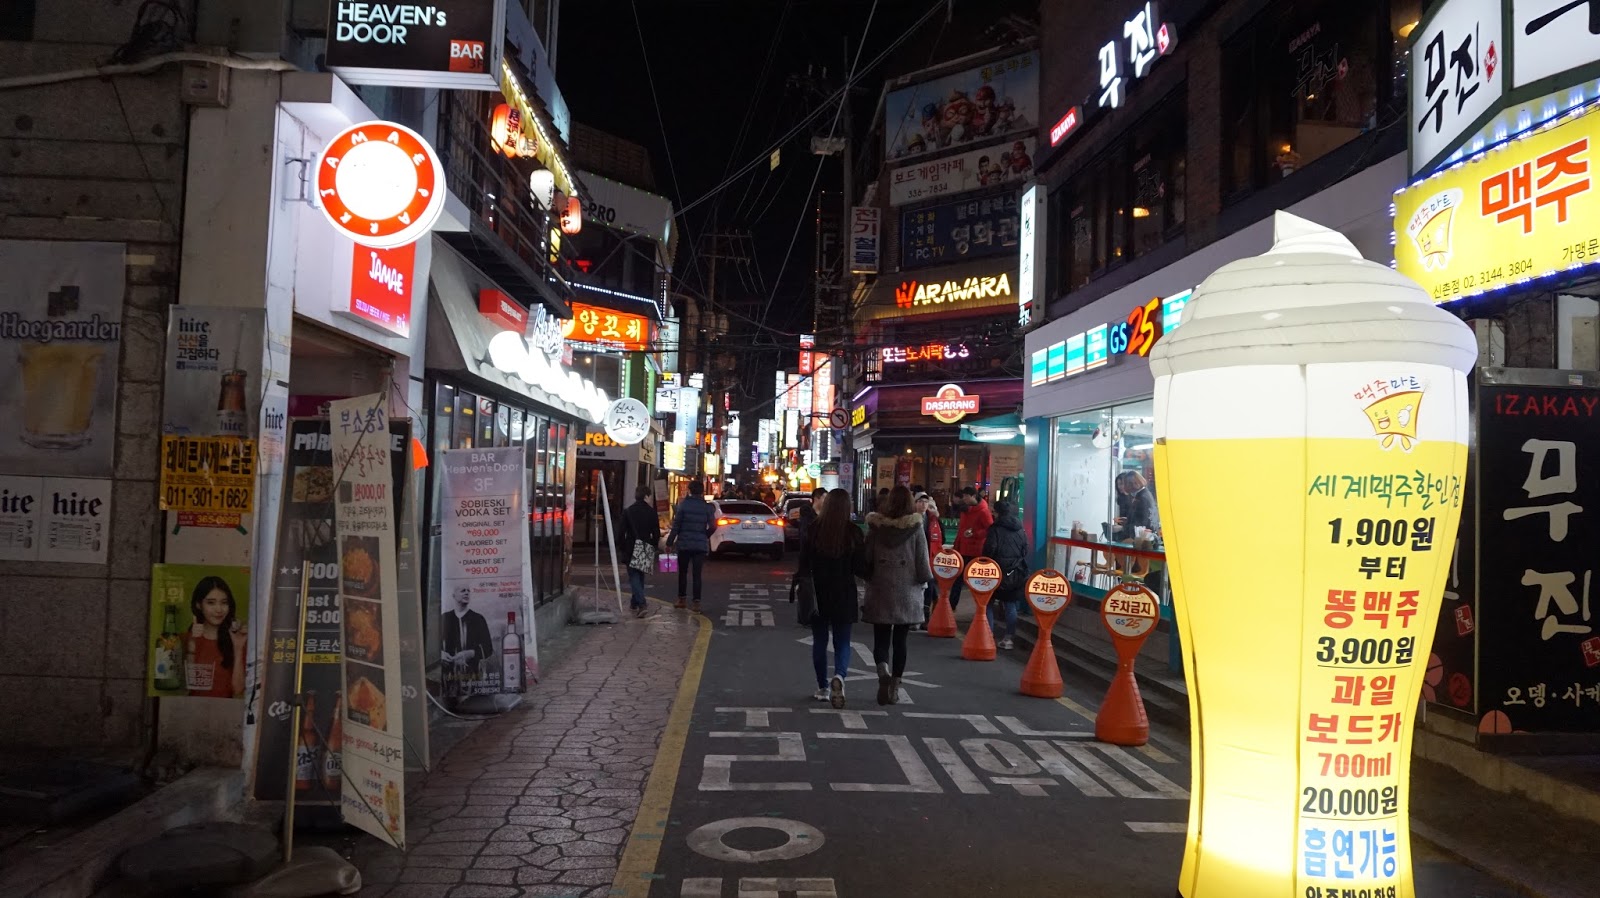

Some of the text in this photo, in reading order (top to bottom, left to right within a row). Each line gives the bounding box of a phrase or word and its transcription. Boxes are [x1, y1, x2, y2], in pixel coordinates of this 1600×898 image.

[338, 2, 447, 27] HEAVEN's
[336, 23, 408, 44] DOOR
[451, 43, 484, 60] BAR
[470, 59, 484, 69] 3F
[1098, 1, 1156, 108] 무진
[1418, 21, 1481, 133] 무진
[1051, 112, 1076, 144] IZAKAYA
[908, 183, 948, 199] 336-7834
[1481, 138, 1591, 234] 맥주
[1410, 194, 1452, 232] 맥주마트
[916, 246, 945, 259] PC TV
[369, 252, 404, 296] JAMAE
[1433, 279, 1461, 300] 신촌점
[1508, 258, 1533, 277] 3804
[896, 273, 1011, 308] WARAWARA
[1, 312, 121, 342] Hoegaarden
[179, 317, 210, 333] hite
[580, 310, 641, 342] 양꼬치
[1110, 297, 1159, 357] GS25
[1354, 376, 1421, 400] 맥주마트
[926, 400, 975, 411] DASARANG
[1495, 394, 1600, 416] IZAKAY
[264, 407, 284, 430] hite
[445, 462, 519, 475] Heaven's Door
[471, 453, 495, 463] BAR
[474, 477, 494, 492] 3F
[1308, 470, 1462, 511] 세계맥주할인점
[1, 489, 35, 514] ite
[52, 492, 102, 517] hite
[167, 486, 249, 509] 011-301-1662
[461, 499, 505, 509] SOBIESKI
[455, 507, 511, 518] VODKA SET
[1328, 517, 1436, 551] 1,900원
[1503, 438, 1592, 641] 무진
[935, 555, 958, 567] 주차금지
[970, 567, 997, 578] 주차금지
[1358, 556, 1407, 580] 부터
[1032, 581, 1066, 595] 주차금지
[1036, 596, 1057, 606] GS25
[1109, 598, 1152, 615] 주차금지
[1323, 589, 1420, 630] 똥맥주
[1115, 616, 1143, 629] GS25
[1316, 636, 1415, 665] 3,900원
[1331, 674, 1396, 706] 과일
[1503, 682, 1547, 708] 오뎅
[1305, 712, 1402, 744] 보드카
[1318, 752, 1392, 778] 700ml
[1302, 785, 1398, 816] 20,000원
[1304, 828, 1396, 879] 흡연가능
